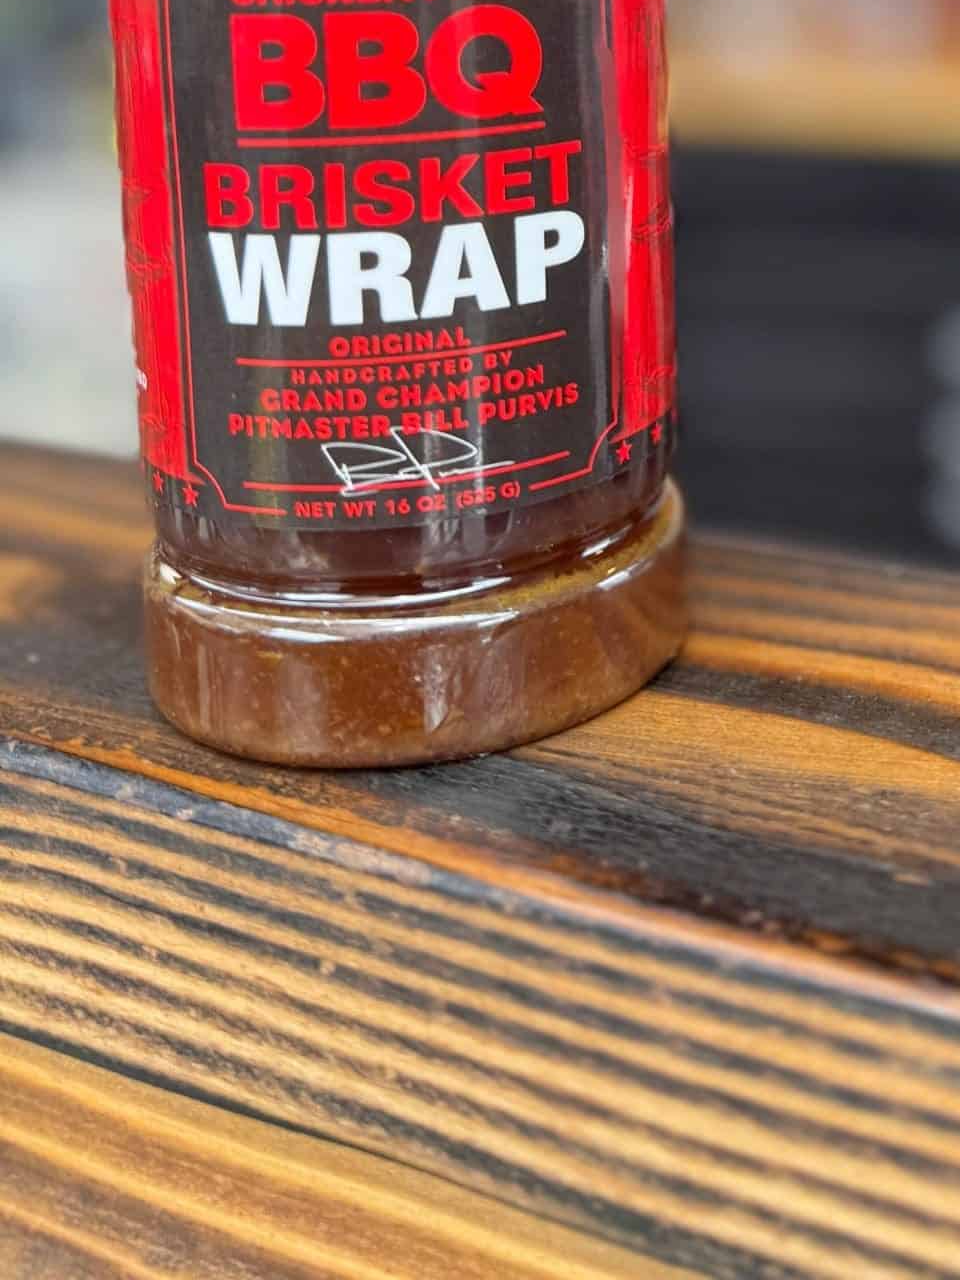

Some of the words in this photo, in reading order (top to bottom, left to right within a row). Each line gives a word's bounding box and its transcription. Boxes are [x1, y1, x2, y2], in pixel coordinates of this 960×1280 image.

[229, 5, 544, 130] BBQ
[202, 141, 581, 229] BRISKET
[208, 210, 584, 327] WRAP
[290, 357, 473, 385] HANDCRAFTED
[484, 350, 512, 369] BY
[328, 326, 471, 358] ORIGINAL
[227, 413, 391, 440] PITMASTER
[402, 407, 470, 436] BILL
[478, 382, 579, 426] PURVIS
[259, 387, 367, 412] GRAND
[376, 364, 544, 409] CHAMPION
[295, 500, 336, 518] NET
[344, 500, 377, 518] WT
[385, 498, 410, 514] 16
[417, 495, 447, 512] OZ
[501, 481, 521, 504] G)
